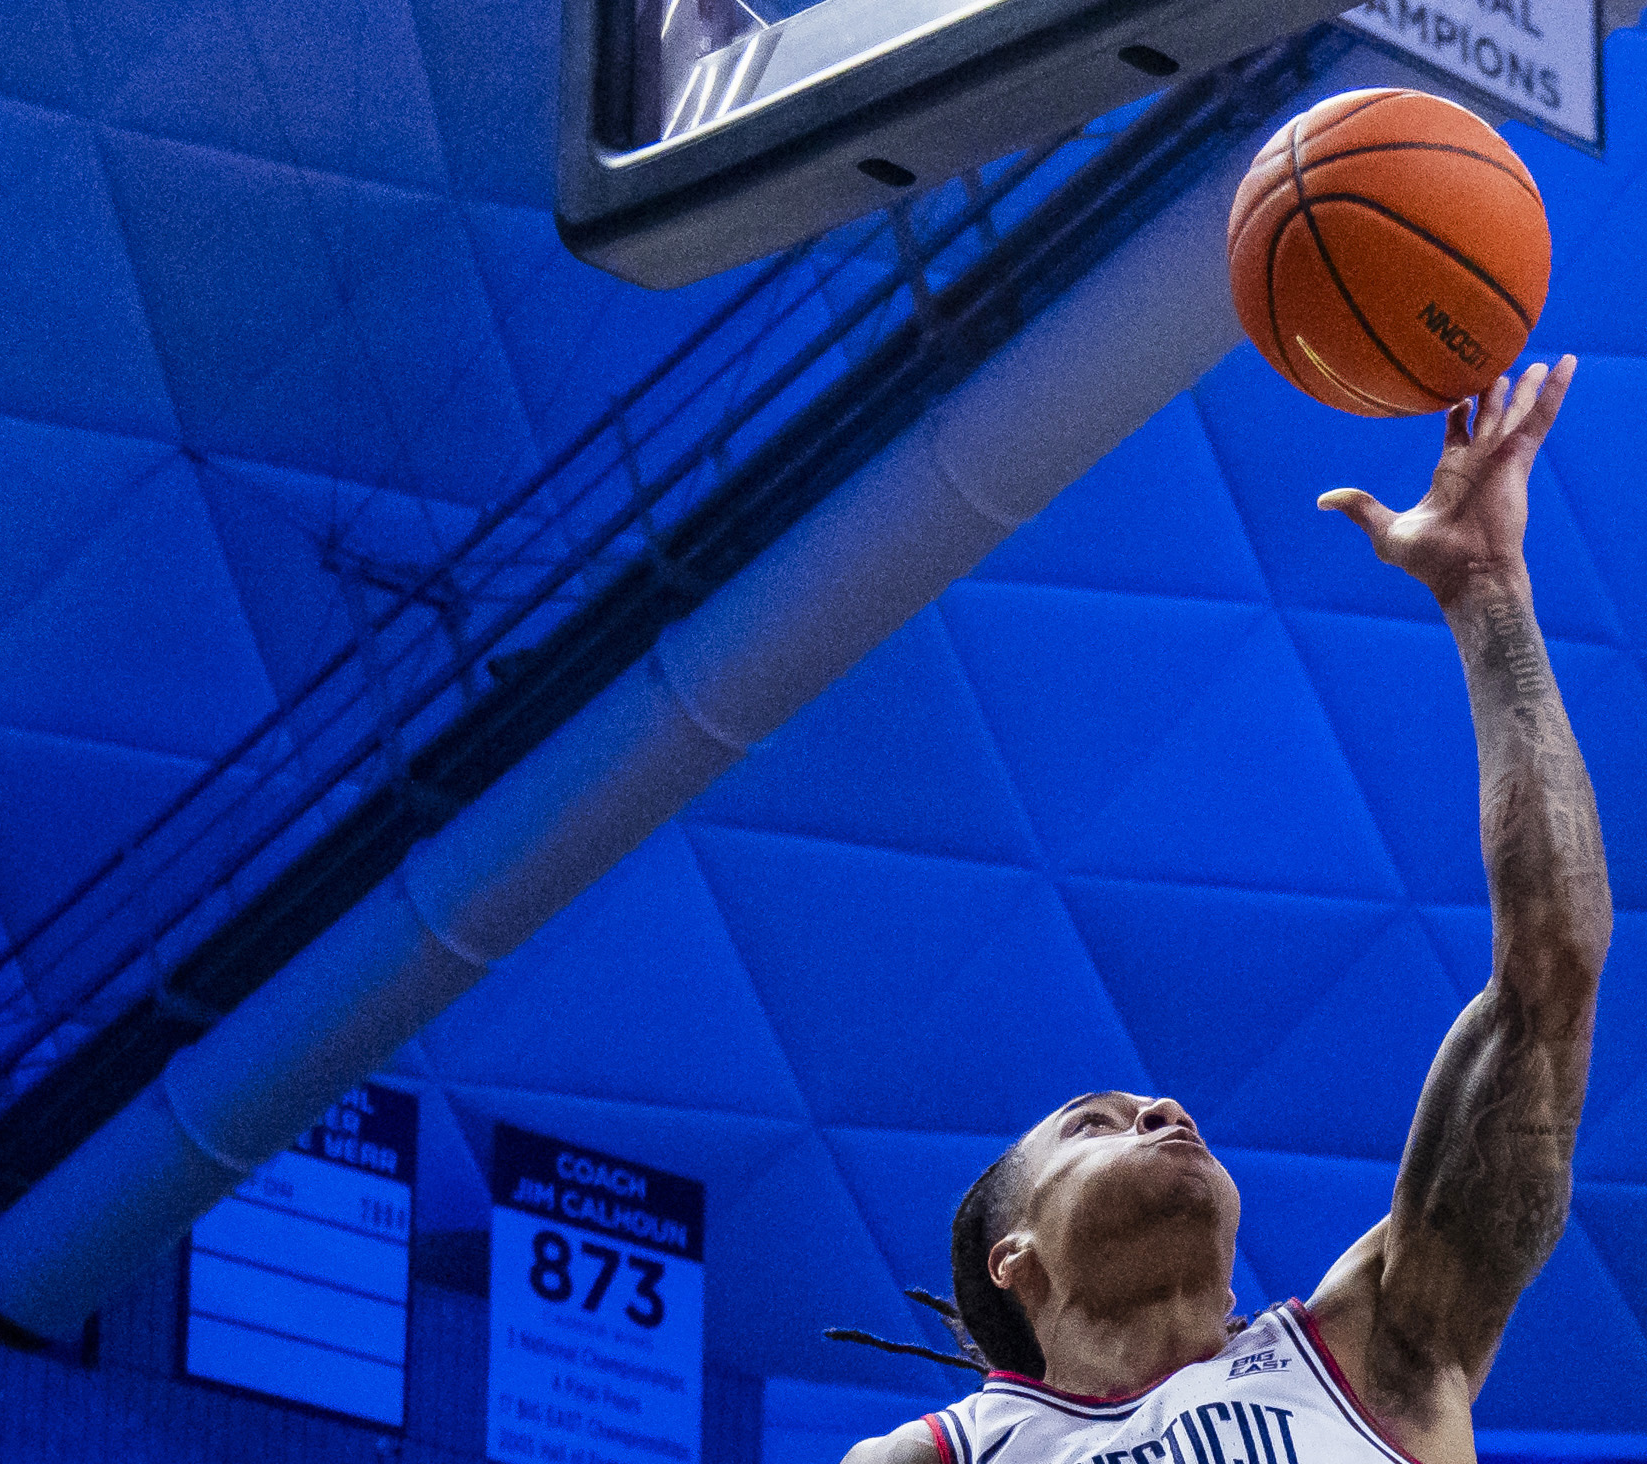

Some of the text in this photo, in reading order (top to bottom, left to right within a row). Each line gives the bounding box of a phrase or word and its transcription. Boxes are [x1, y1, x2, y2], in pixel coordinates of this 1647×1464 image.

[557, 1152, 649, 1200] COACH
[511, 1174, 689, 1250] JIM CALHOUN
[528, 1229, 666, 1329] 873
[1228, 1358, 1293, 1377] EAST
[1232, 1350, 1275, 1368] BIG
